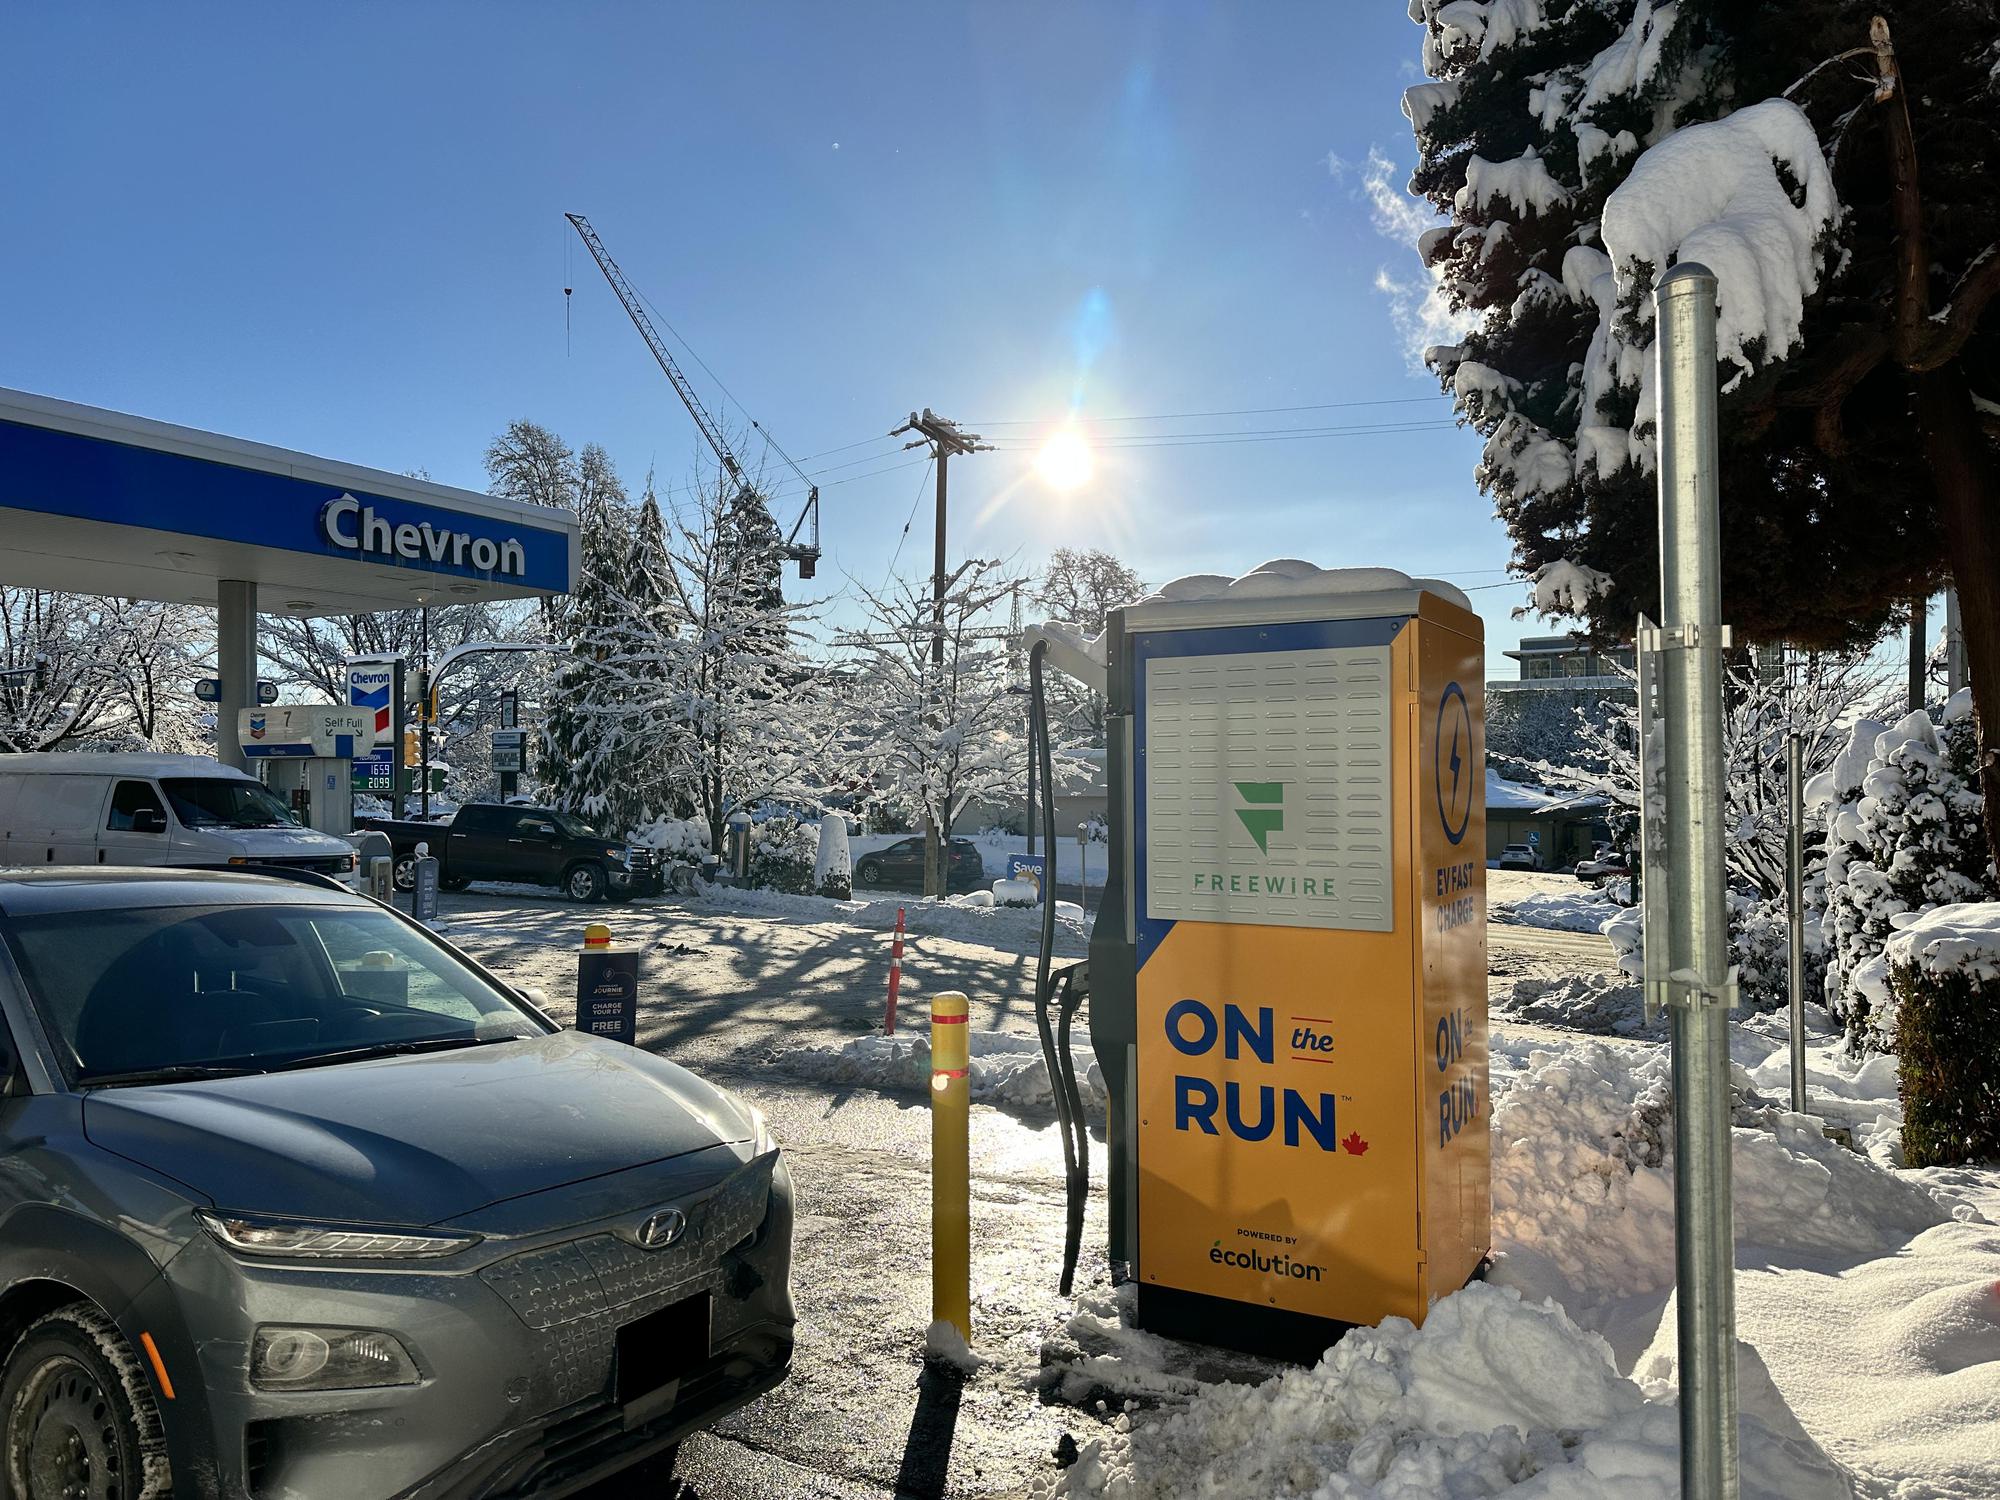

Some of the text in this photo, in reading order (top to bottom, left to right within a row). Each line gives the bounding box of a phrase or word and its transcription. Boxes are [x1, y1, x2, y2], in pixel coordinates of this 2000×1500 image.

[325, 497, 525, 576] Chevron
[351, 672, 390, 684] Chevron
[202, 683, 209, 692] 7
[264, 686, 272, 695] 8
[284, 711, 292, 727] 7
[325, 717, 363, 728] Self Full
[371, 764, 390, 775] 1659
[368, 777, 390, 789] 2099
[1013, 861, 1043, 875] Save
[1437, 862, 1474, 896] EV FAST
[1437, 896, 1474, 933] CHARGE
[592, 1021, 621, 1030] FREE
[1164, 999, 1335, 1065] ON the
[1436, 1008, 1462, 1072] ON
[1174, 1075, 1336, 1152] RUN
[1440, 1066, 1475, 1149] RUN
[1237, 1228, 1298, 1245] POWERED BY
